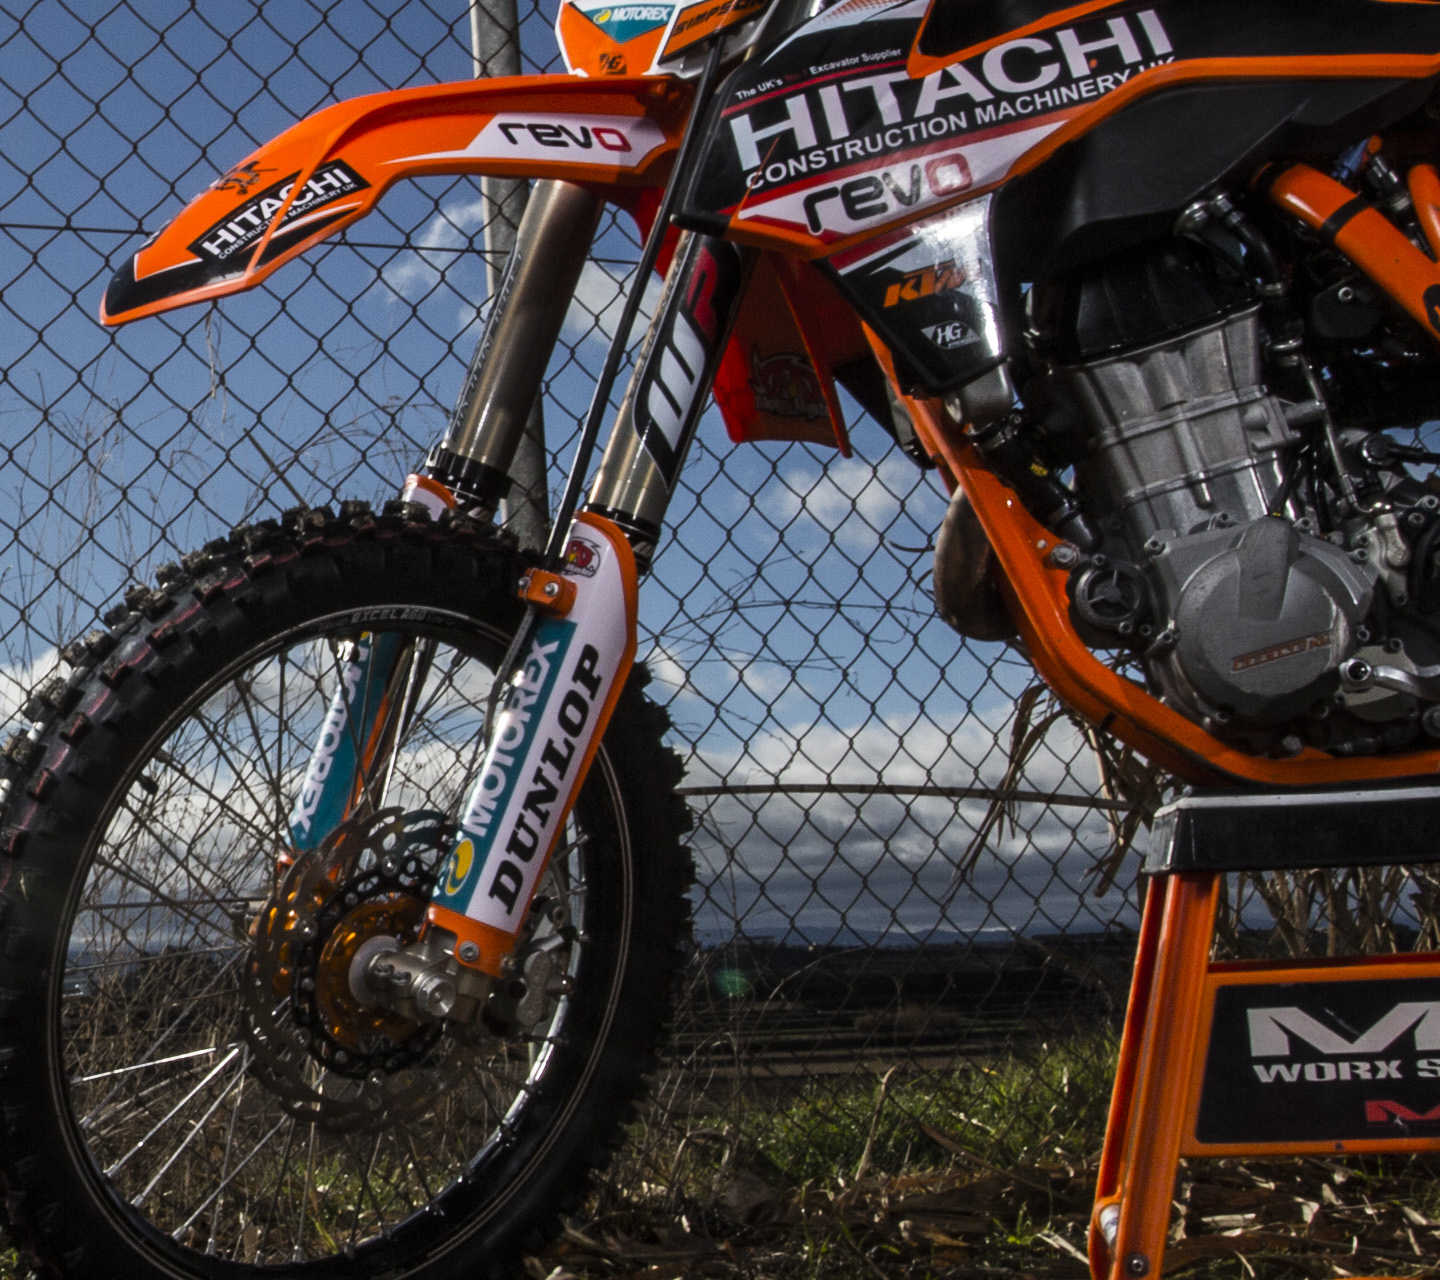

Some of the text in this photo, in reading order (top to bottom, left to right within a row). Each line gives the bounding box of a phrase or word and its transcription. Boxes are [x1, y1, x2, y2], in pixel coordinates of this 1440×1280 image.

[610, 6, 671, 22] MOTOREX
[729, 9, 1174, 171] HITACHI
[736, 90, 756, 100] The
[758, 79, 783, 93] UK's
[809, 56, 860, 75] Excavator
[861, 48, 902, 62] Supplier
[498, 123, 632, 153] revo
[745, 68, 1131, 190] CONSTRUCTION MACHINERY
[201, 168, 352, 256] HITACHI
[288, 187, 342, 220] MACHINERY
[803, 153, 974, 233] revo
[464, 638, 560, 838] MOTOREX
[488, 643, 603, 916] DUNLOP
[1252, 1058, 1405, 1084] WORX
